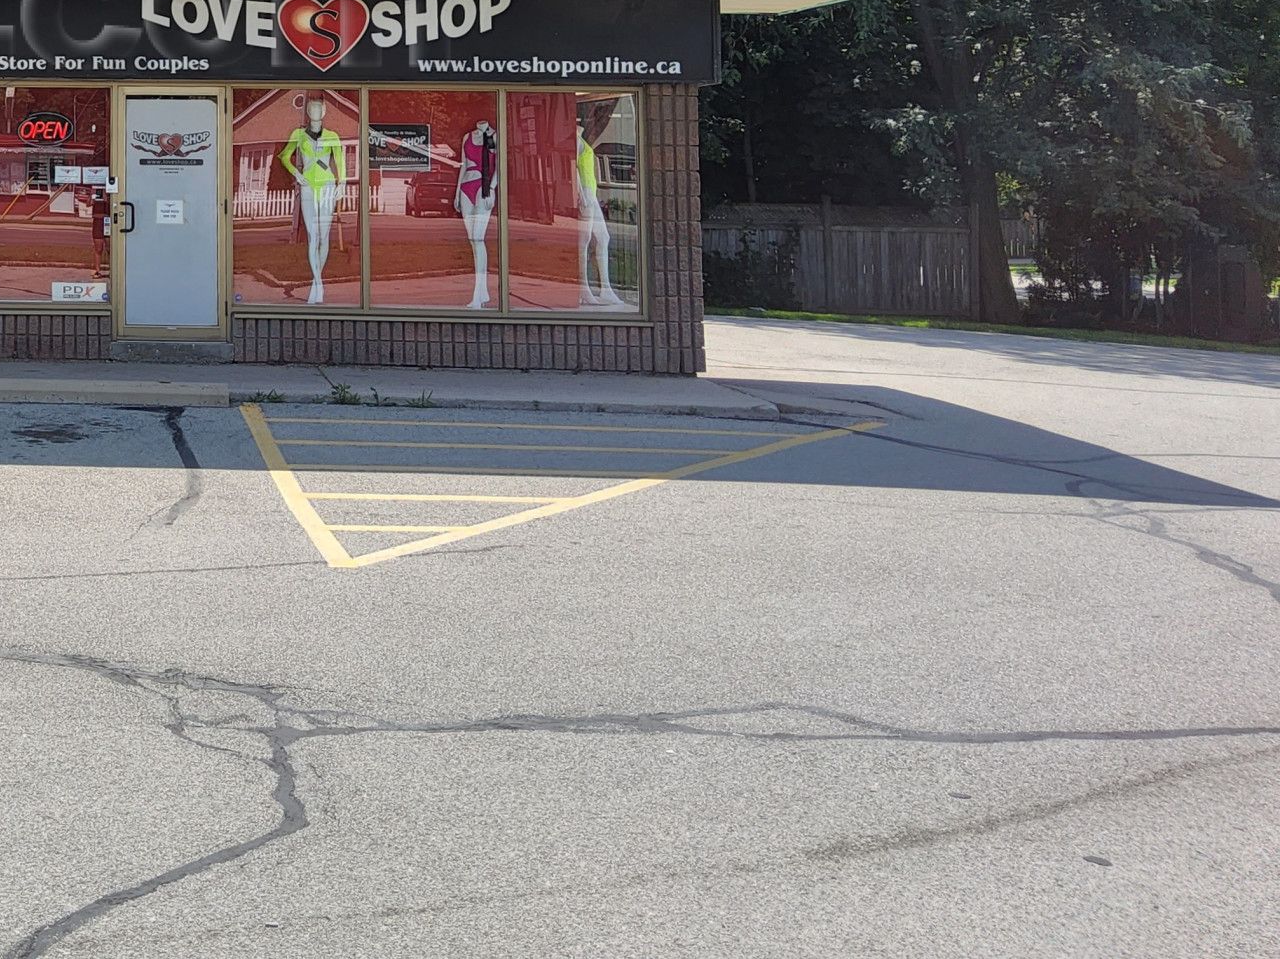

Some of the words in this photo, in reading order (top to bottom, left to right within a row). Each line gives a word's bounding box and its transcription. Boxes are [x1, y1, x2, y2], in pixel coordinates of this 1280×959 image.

[308, 8, 340, 59] S
[54, 55, 84, 71] For
[92, 55, 126, 71] Fun
[134, 55, 210, 74] Couples
[417, 56, 681, 77] www.loveshoponline.ca
[20, 121, 69, 139] OPEN
[133, 131, 160, 146] LOVE
[183, 131, 210, 146] SHOP
[368, 136, 387, 147] OVE
[401, 135, 426, 146] SHOP
